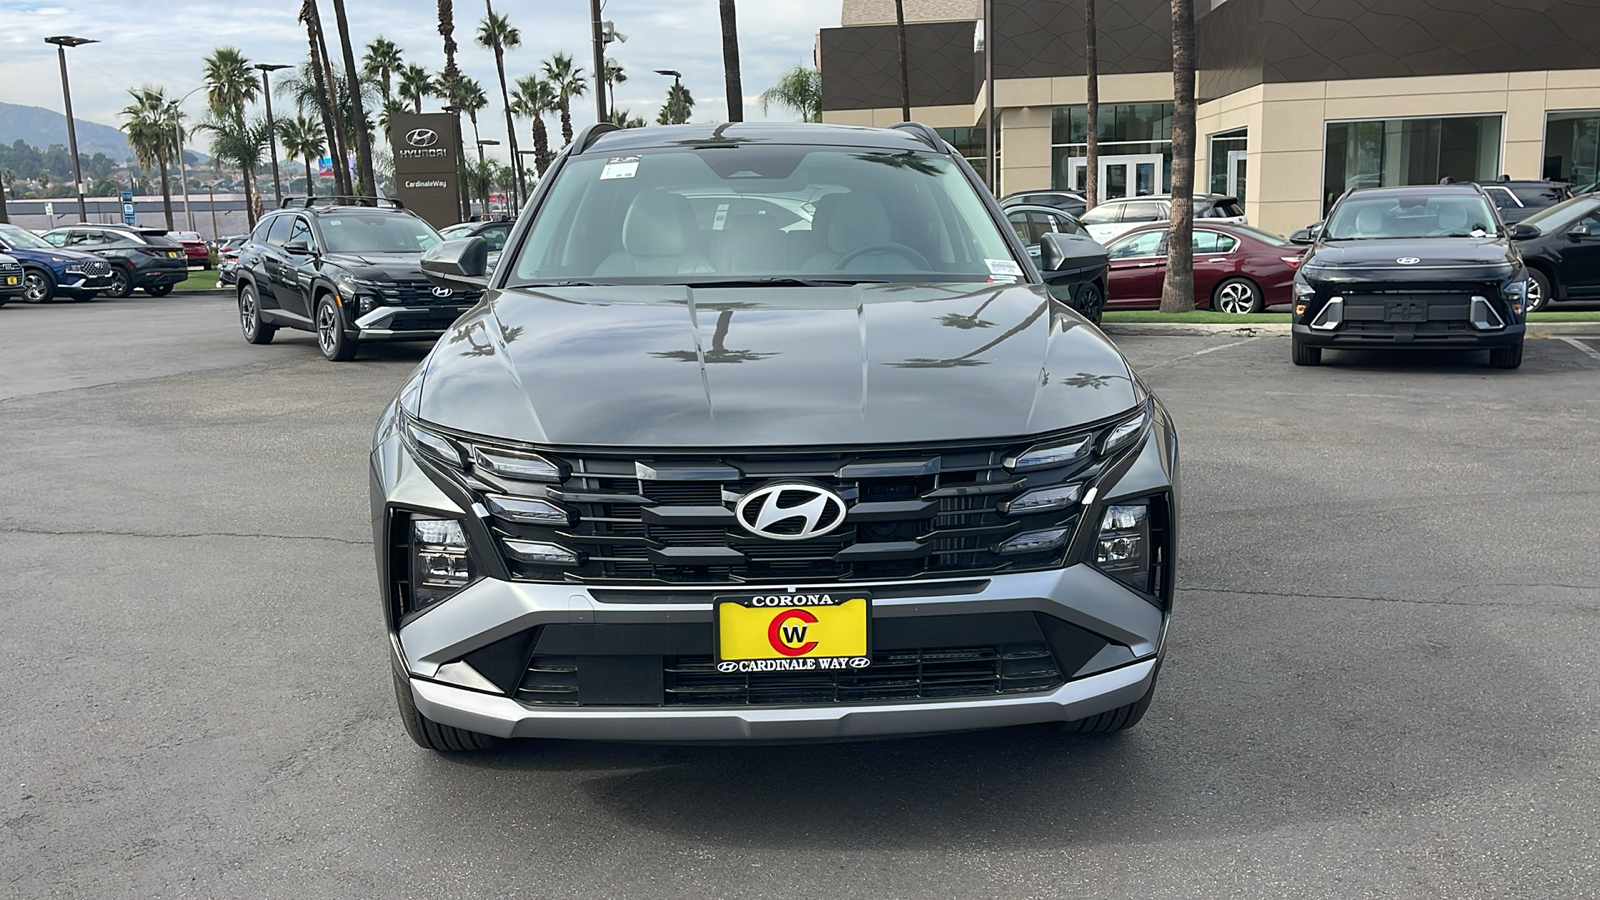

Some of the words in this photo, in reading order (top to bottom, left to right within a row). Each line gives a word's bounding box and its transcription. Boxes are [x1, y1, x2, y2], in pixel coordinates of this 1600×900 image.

[399, 148, 447, 158] HYUNDAI
[405, 180, 447, 188] CardinaleWay
[752, 594, 833, 607] CORONA
[739, 658, 816, 672] CARDINALE
[818, 657, 849, 670] WAY
